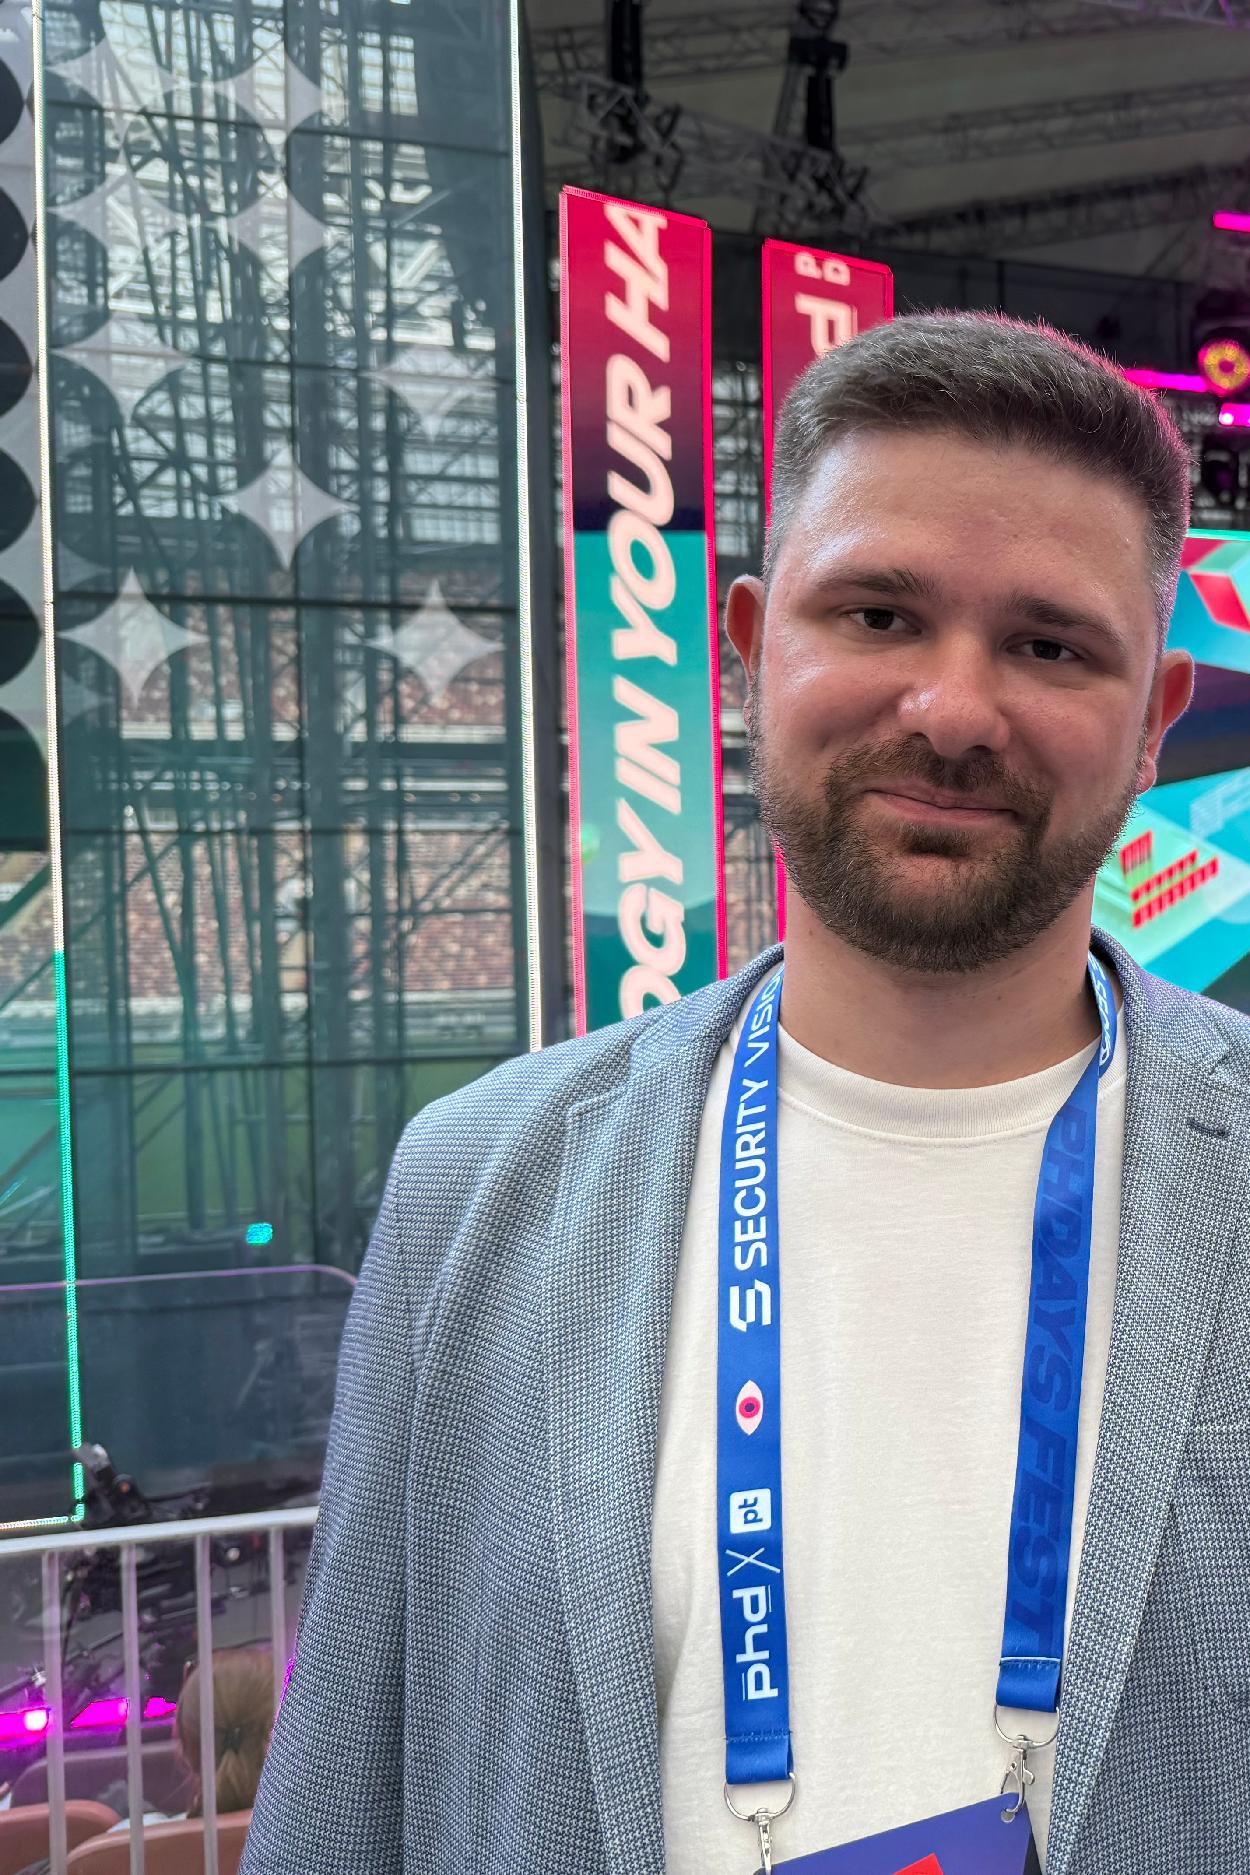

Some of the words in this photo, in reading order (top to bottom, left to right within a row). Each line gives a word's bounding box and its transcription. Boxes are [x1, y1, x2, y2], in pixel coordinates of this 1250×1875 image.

[606, 354, 676, 666] YOUR
[613, 675, 681, 815] IN
[734, 1078, 769, 1271] SECURITY
[1028, 1104, 1088, 1412] PHDAYS
[738, 1497, 764, 1525] pt
[1010, 1415, 1067, 1654] FEST
[732, 1585, 779, 1700] phd
